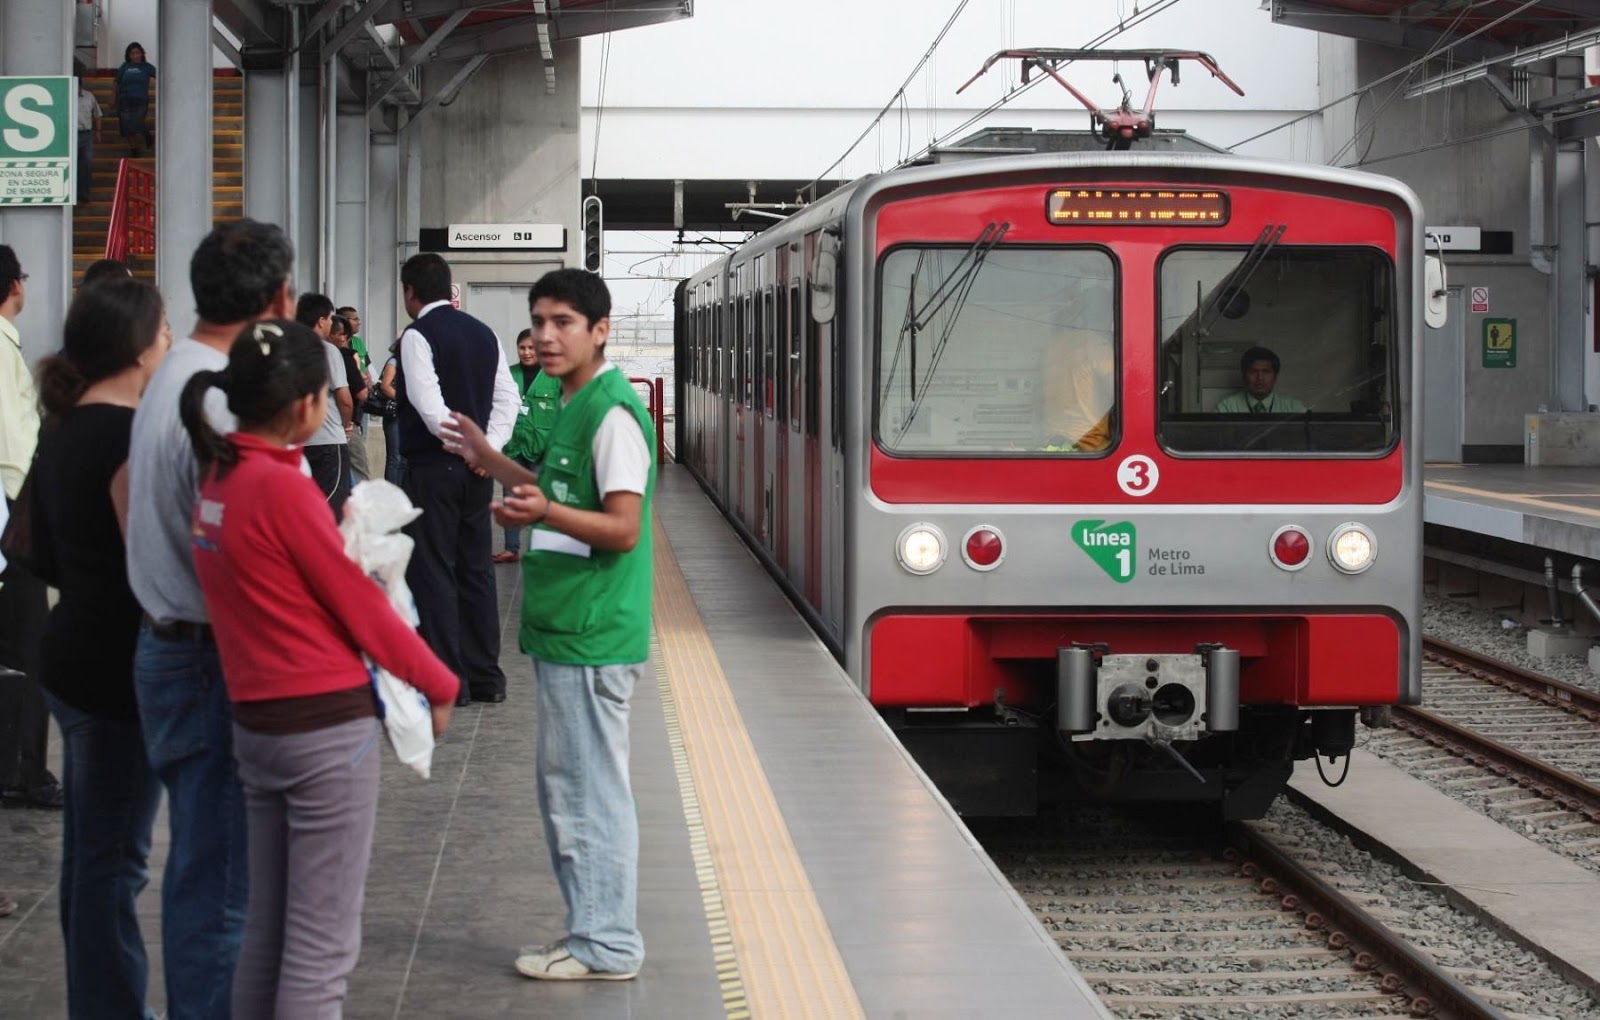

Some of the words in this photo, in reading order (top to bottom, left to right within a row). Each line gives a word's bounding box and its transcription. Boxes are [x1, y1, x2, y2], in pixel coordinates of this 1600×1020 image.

[3, 83, 55, 152] S
[0, 170, 23, 178] ZONA
[25, 170, 59, 178] SEGURA
[6, 187, 17, 195] DE
[20, 187, 52, 195] SISMOS
[455, 232, 501, 241] Ascensor
[1126, 460, 1150, 491] 3
[1148, 548, 1191, 560] Metro
[1115, 548, 1131, 577] 1
[1148, 562, 1167, 576] de
[1170, 562, 1206, 576] Lima
